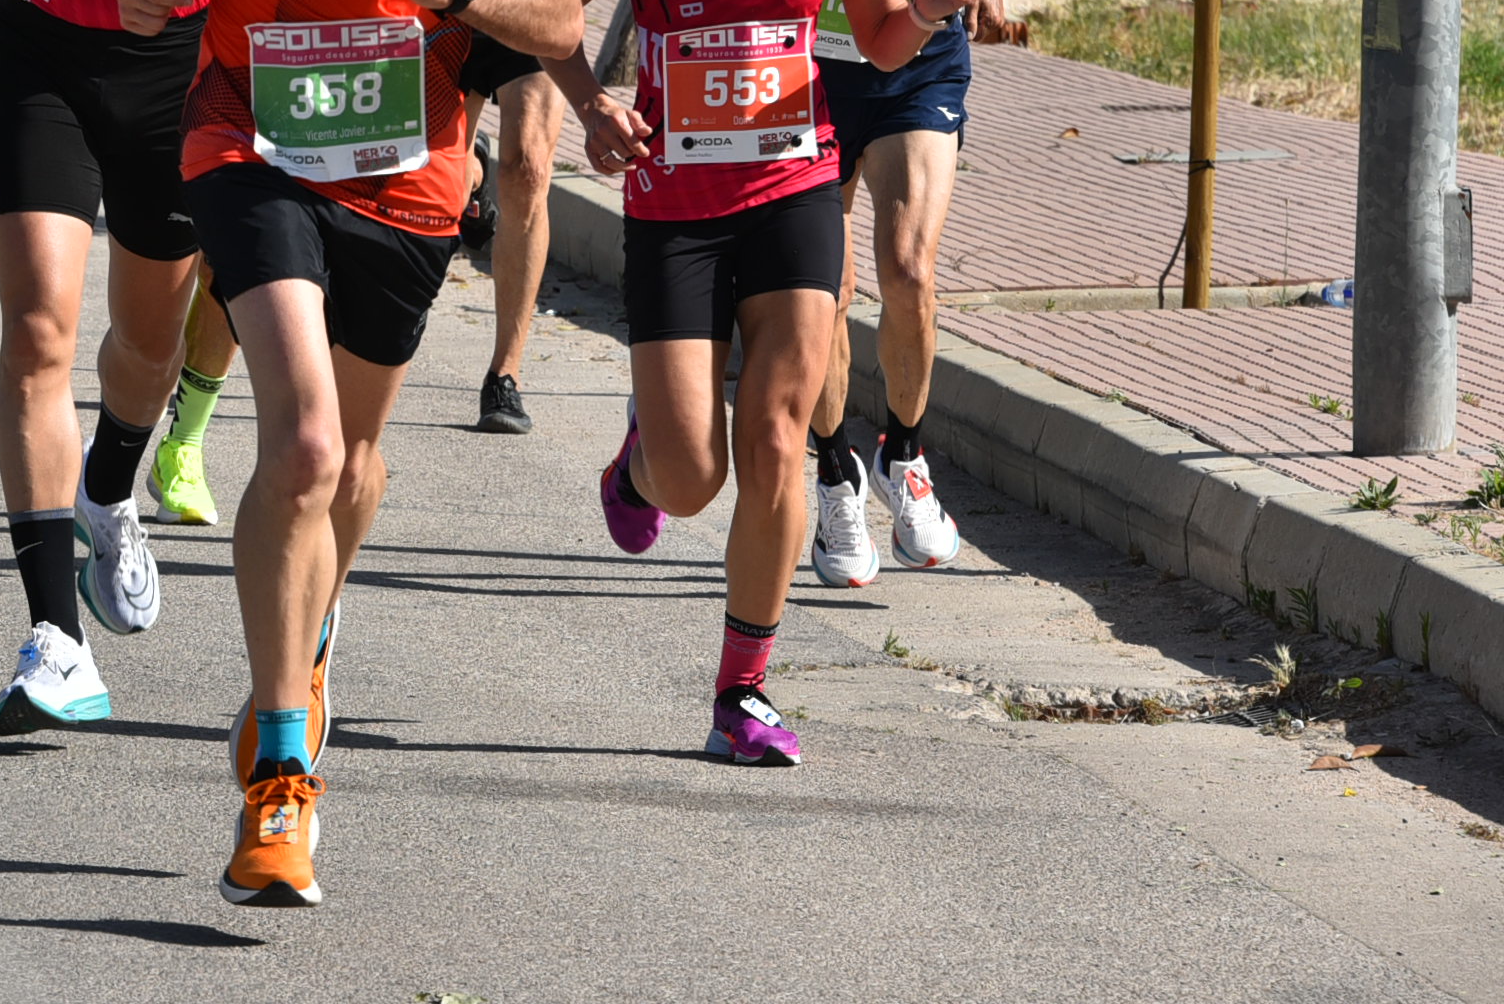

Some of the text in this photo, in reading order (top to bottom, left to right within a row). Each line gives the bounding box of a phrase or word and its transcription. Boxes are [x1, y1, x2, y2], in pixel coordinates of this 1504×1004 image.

[263, 23, 406, 50] SOLISS
[679, 24, 798, 48] SOLISS
[281, 52, 320, 62] Seguros
[325, 51, 358, 60] desde
[696, 50, 734, 58] Seguros
[738, 48, 763, 56] desde
[289, 71, 383, 120] 358
[703, 67, 781, 107] 553
[305, 129, 338, 142] Vicente
[685, 137, 733, 146] KODA
